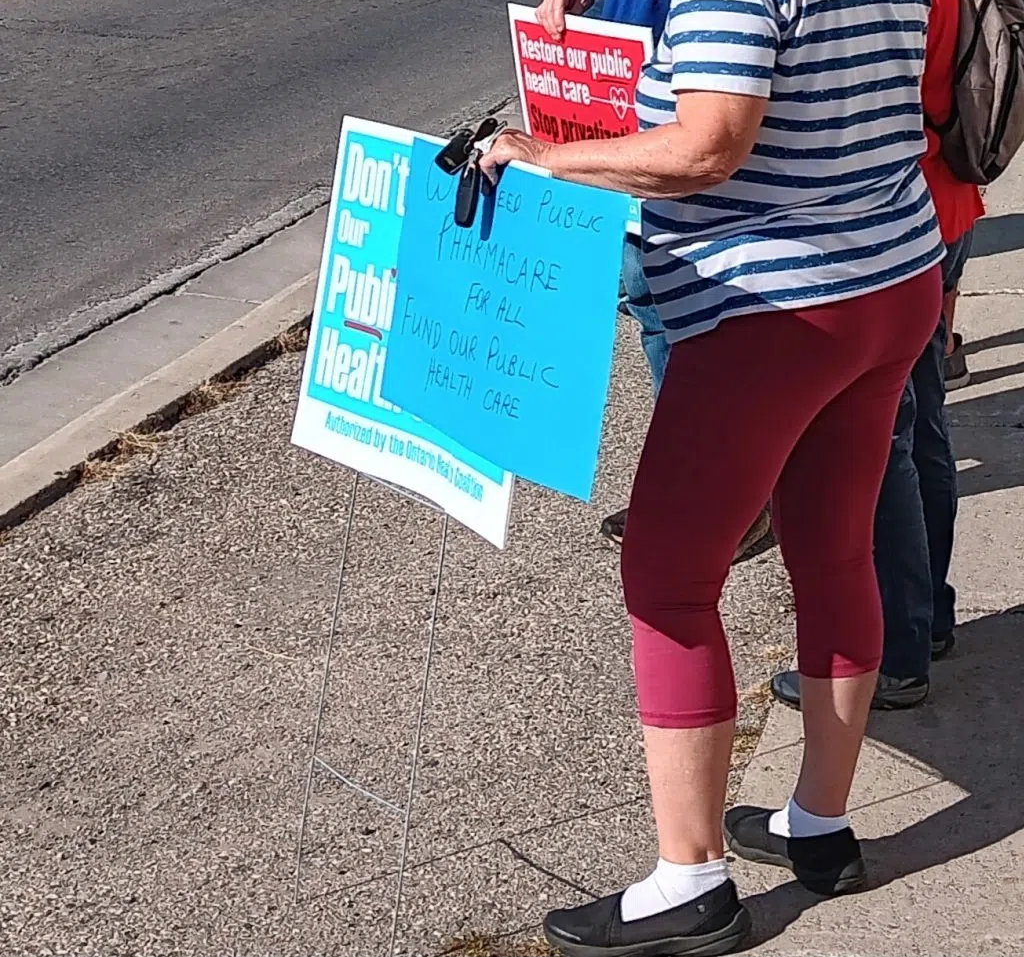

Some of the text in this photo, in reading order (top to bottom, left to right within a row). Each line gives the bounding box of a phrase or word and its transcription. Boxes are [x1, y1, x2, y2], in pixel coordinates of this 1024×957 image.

[519, 30, 633, 80] Restore our public
[523, 64, 591, 105] health care
[530, 104, 560, 143] Stop
[342, 141, 410, 216] Don't
[337, 208, 370, 248] Our
[497, 189, 521, 213] EED
[537, 189, 605, 234] PUBLIC
[437, 212, 561, 292] PHARMACARE
[326, 253, 397, 331] Publi
[464, 282, 526, 328] FOR ALL
[401, 294, 559, 388] FUND OUR PUBLIC
[314, 326, 400, 413] Healt
[424, 357, 520, 420] HEALTH CARE
[324, 411, 372, 446] Authorized
[374, 428, 387, 453] by
[389, 434, 405, 457] the
